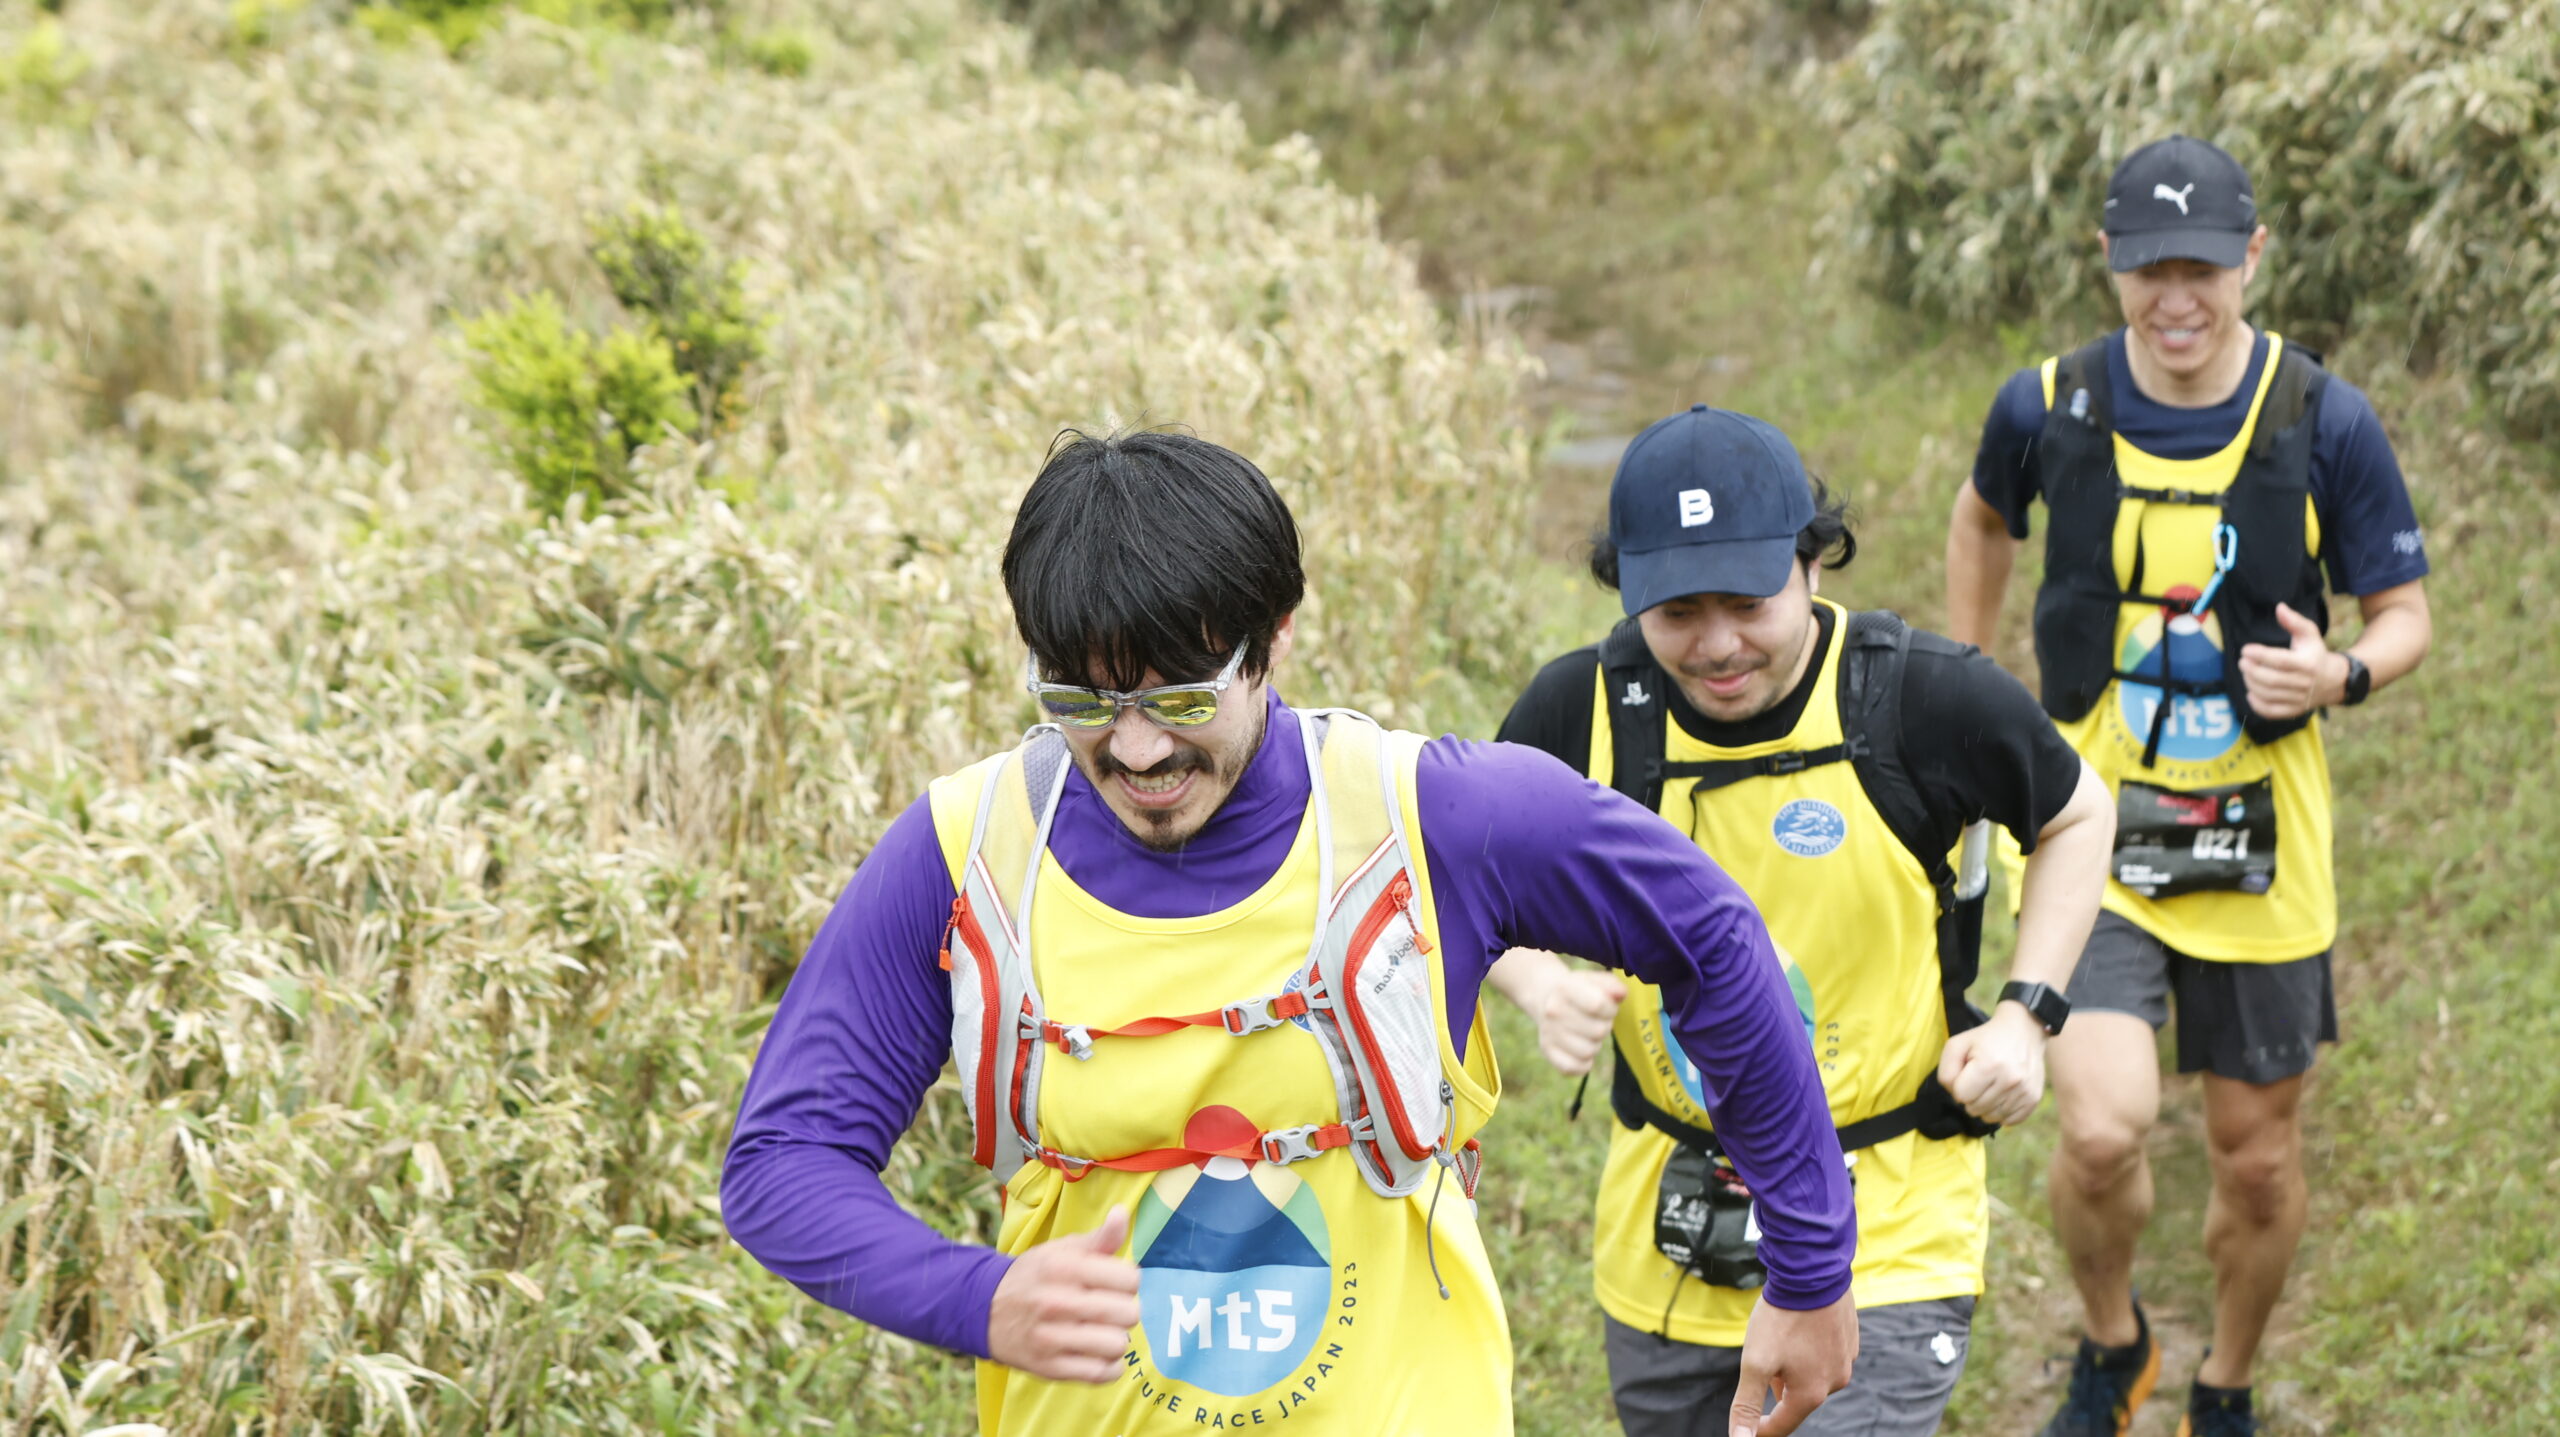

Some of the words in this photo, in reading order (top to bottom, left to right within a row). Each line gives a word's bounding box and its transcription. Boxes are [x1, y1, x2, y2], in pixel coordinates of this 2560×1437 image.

[1678, 488, 1714, 528] B
[1823, 1021, 1840, 1071] 2023
[1124, 1334, 1182, 1413] NTURE
[1195, 1406, 1265, 1430] RACE
[1278, 1342, 1344, 1419] JAPAN
[1338, 1261, 1358, 1327] 2023
